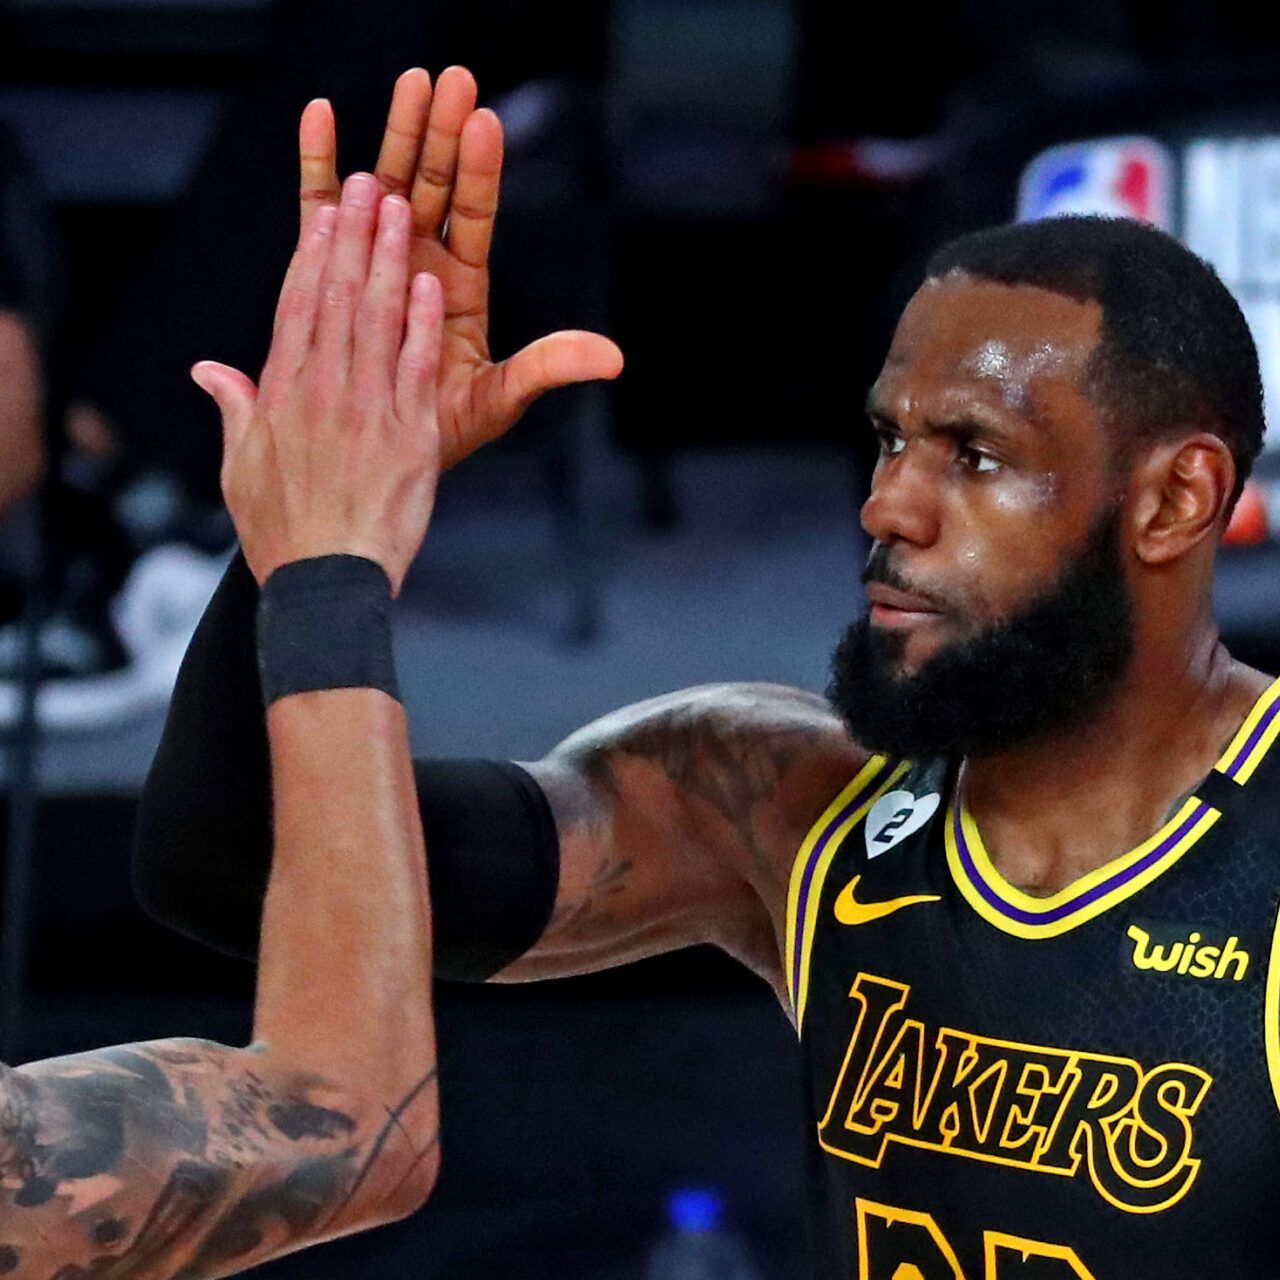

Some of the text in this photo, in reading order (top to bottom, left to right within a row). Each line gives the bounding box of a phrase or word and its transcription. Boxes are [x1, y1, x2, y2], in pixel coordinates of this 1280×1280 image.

[872, 807, 914, 844] 2
[1127, 925, 1250, 982] wish
[817, 972, 1213, 1214] LAKERS
